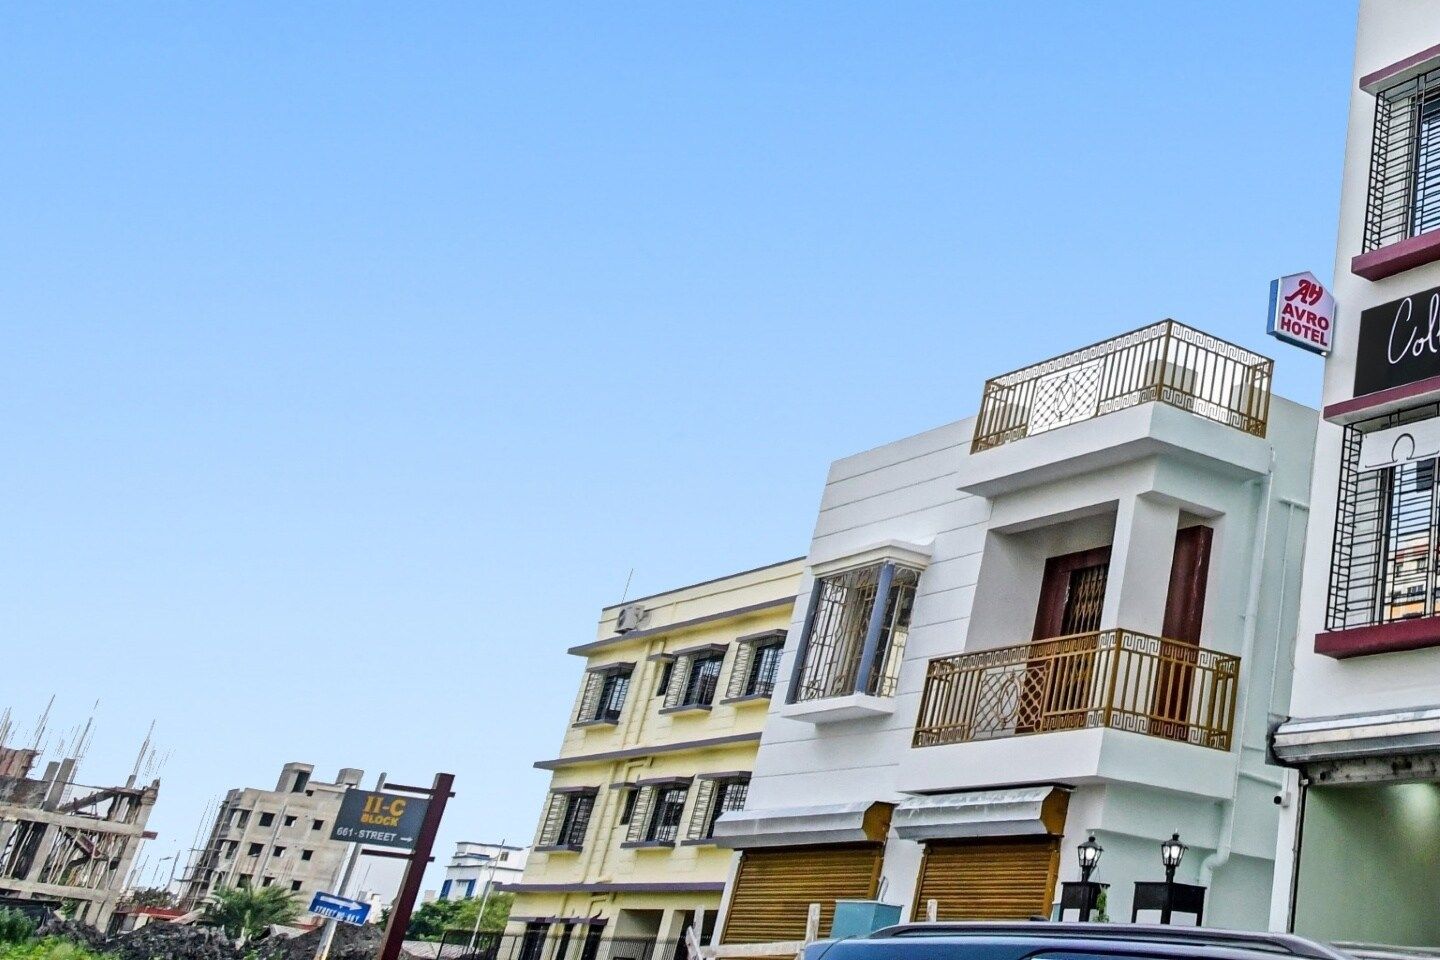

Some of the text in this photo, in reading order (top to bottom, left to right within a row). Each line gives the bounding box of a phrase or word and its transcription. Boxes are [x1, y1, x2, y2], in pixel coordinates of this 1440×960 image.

[1282, 302, 1329, 331] AVRO
[1280, 316, 1328, 347] HOTEL
[360, 813, 399, 827] BLOCK
